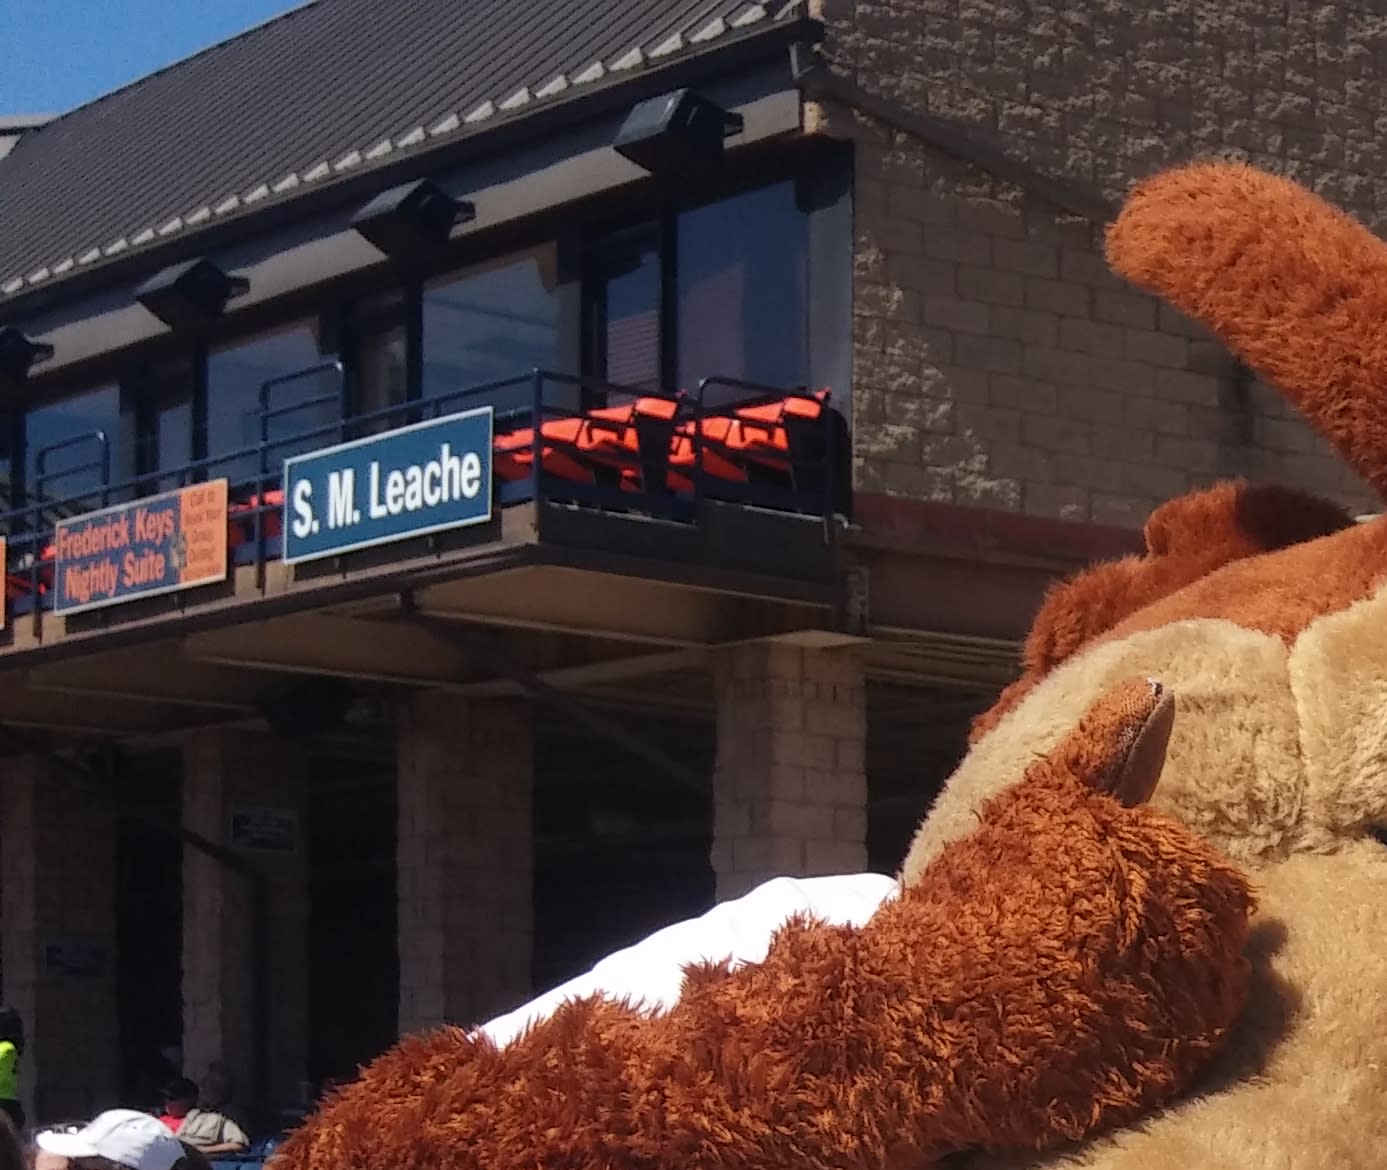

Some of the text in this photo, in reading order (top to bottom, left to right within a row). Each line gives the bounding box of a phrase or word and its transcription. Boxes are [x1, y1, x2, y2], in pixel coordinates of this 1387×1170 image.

[293, 441, 482, 539] S. M. Leache
[58, 515, 130, 562] Frederick
[134, 507, 175, 547] Keys
[64, 549, 166, 604] Nightly Suite
